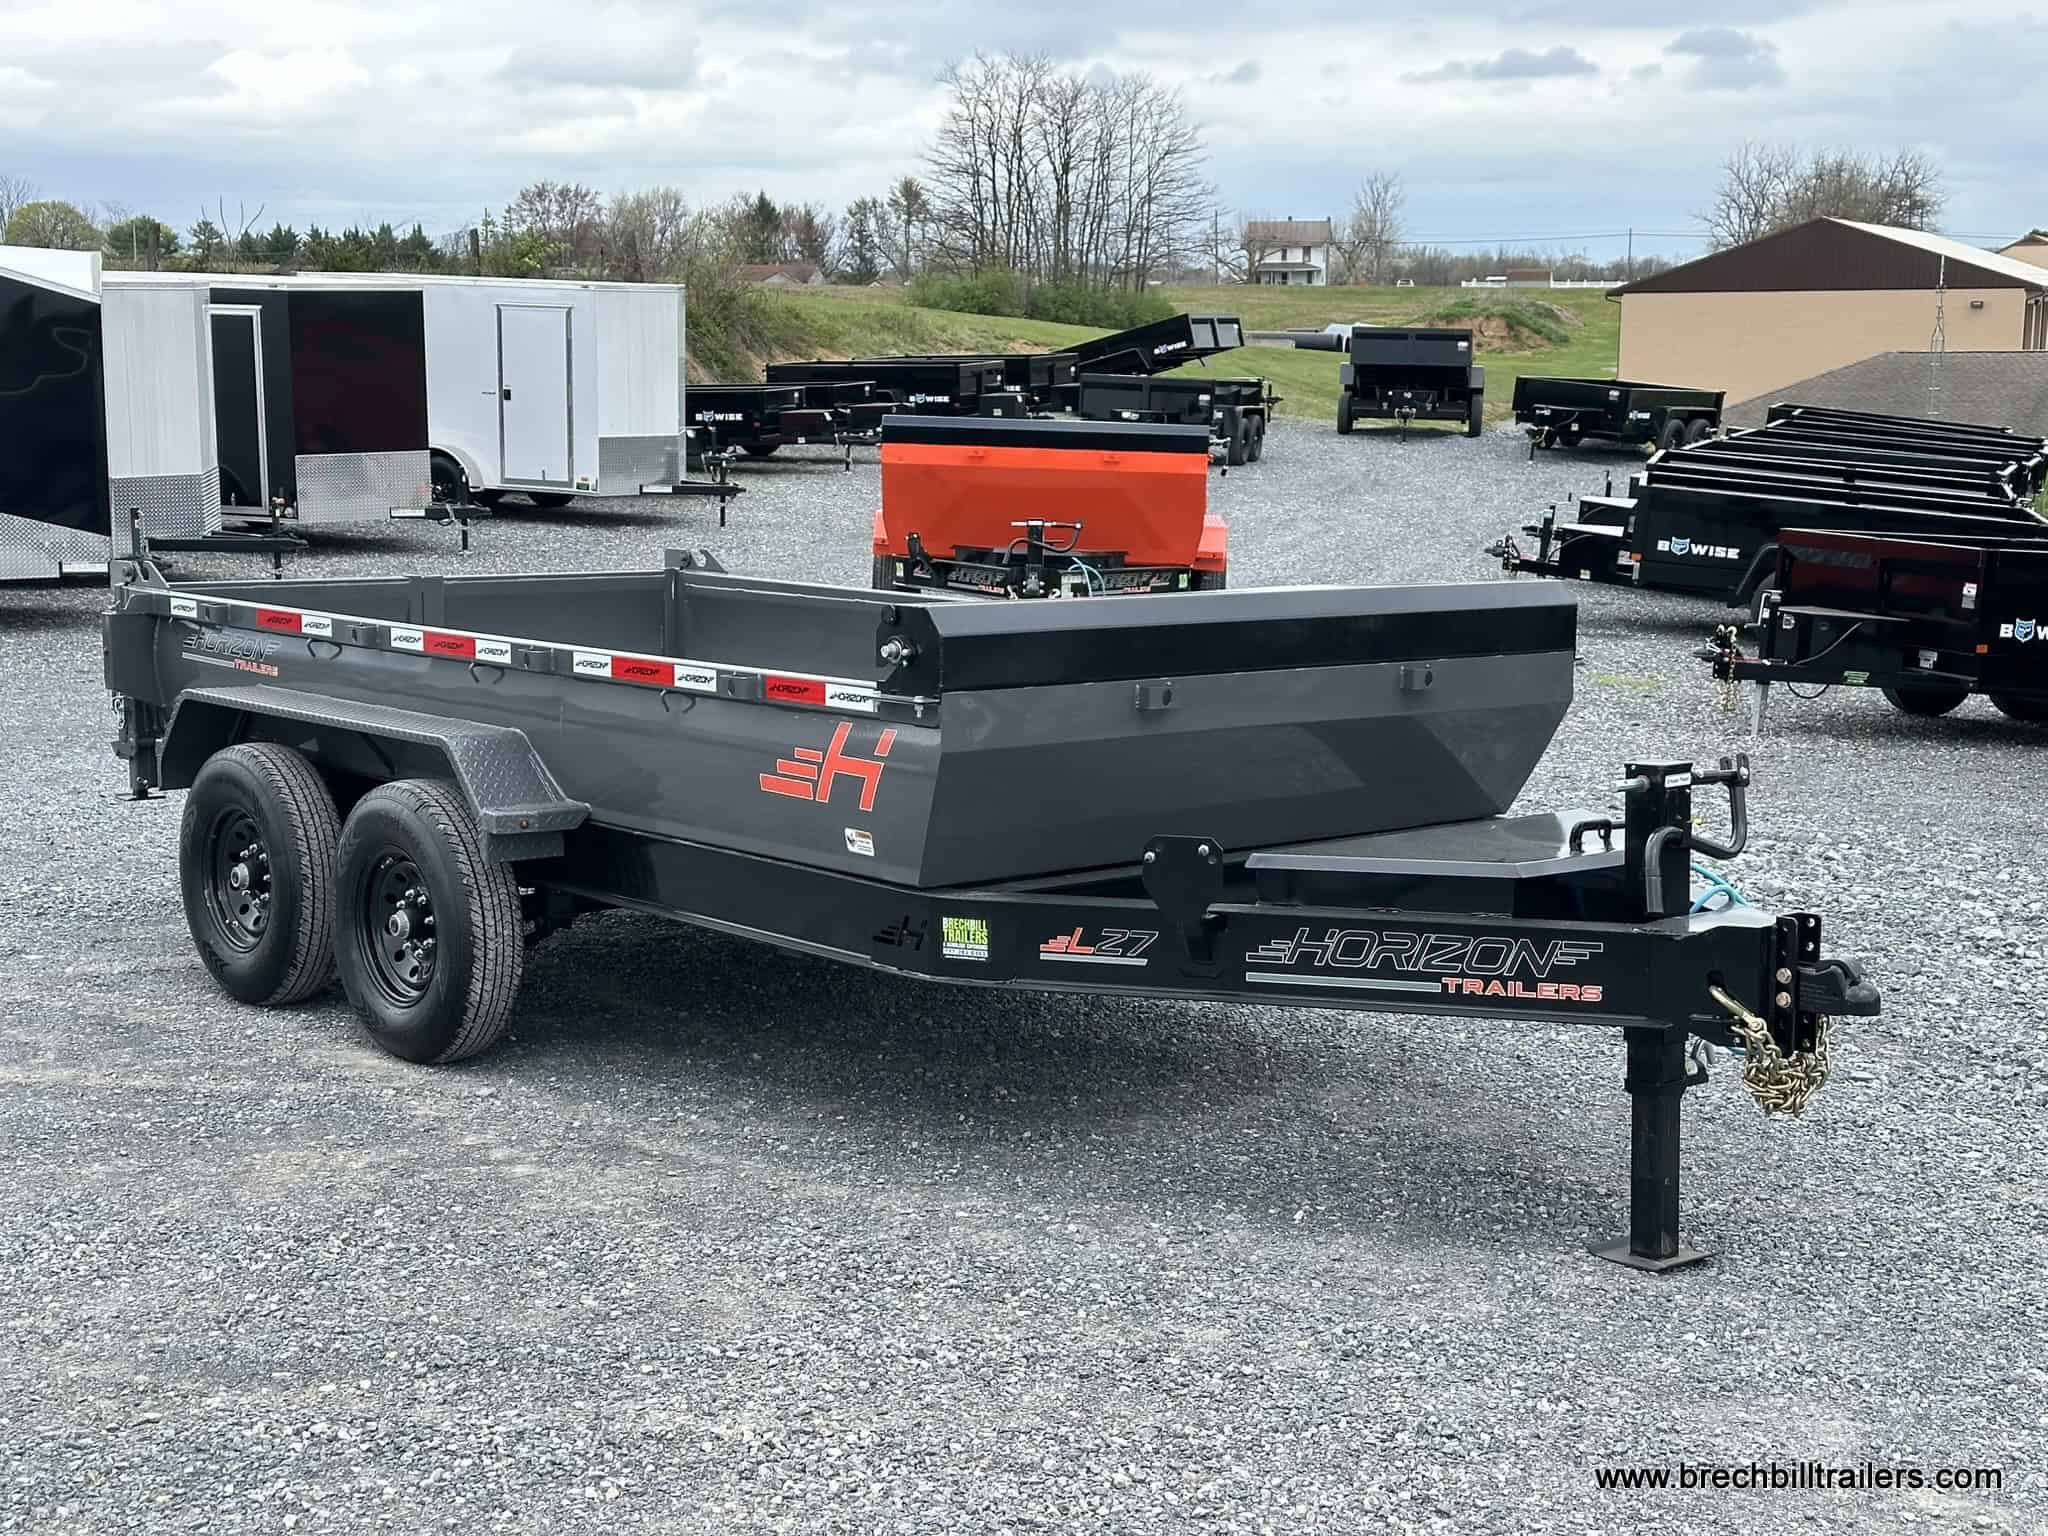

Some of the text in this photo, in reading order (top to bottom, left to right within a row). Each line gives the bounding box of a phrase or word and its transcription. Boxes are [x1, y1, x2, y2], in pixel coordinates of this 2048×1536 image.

[191, 628, 268, 661] HORIZON
[942, 916, 988, 931] BRECHBILL
[943, 929, 988, 945] TRAILERS
[1285, 927, 1562, 978] HORIZON
[1441, 977, 1604, 1001] TRAILERS
